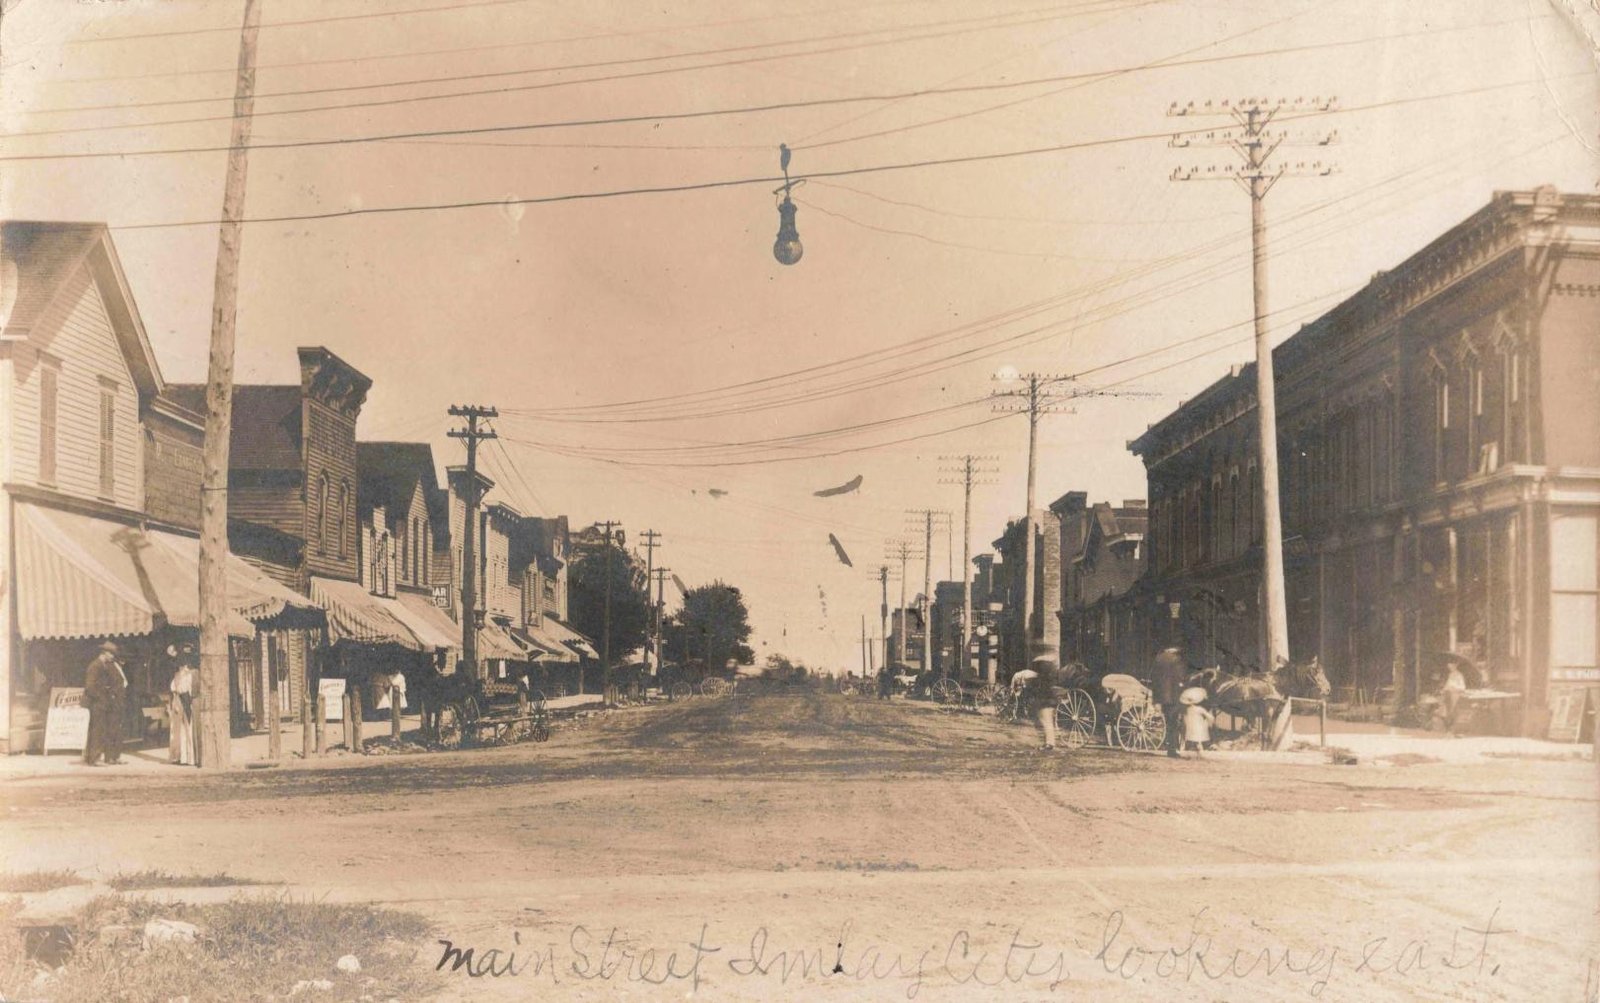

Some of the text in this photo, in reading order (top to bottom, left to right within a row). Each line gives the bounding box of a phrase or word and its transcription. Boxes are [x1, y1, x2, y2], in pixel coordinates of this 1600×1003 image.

[570, 923, 721, 992] Street
[728, 919, 930, 998] Imlay
[944, 928, 1070, 991] City
[1095, 906, 1340, 997] looking
